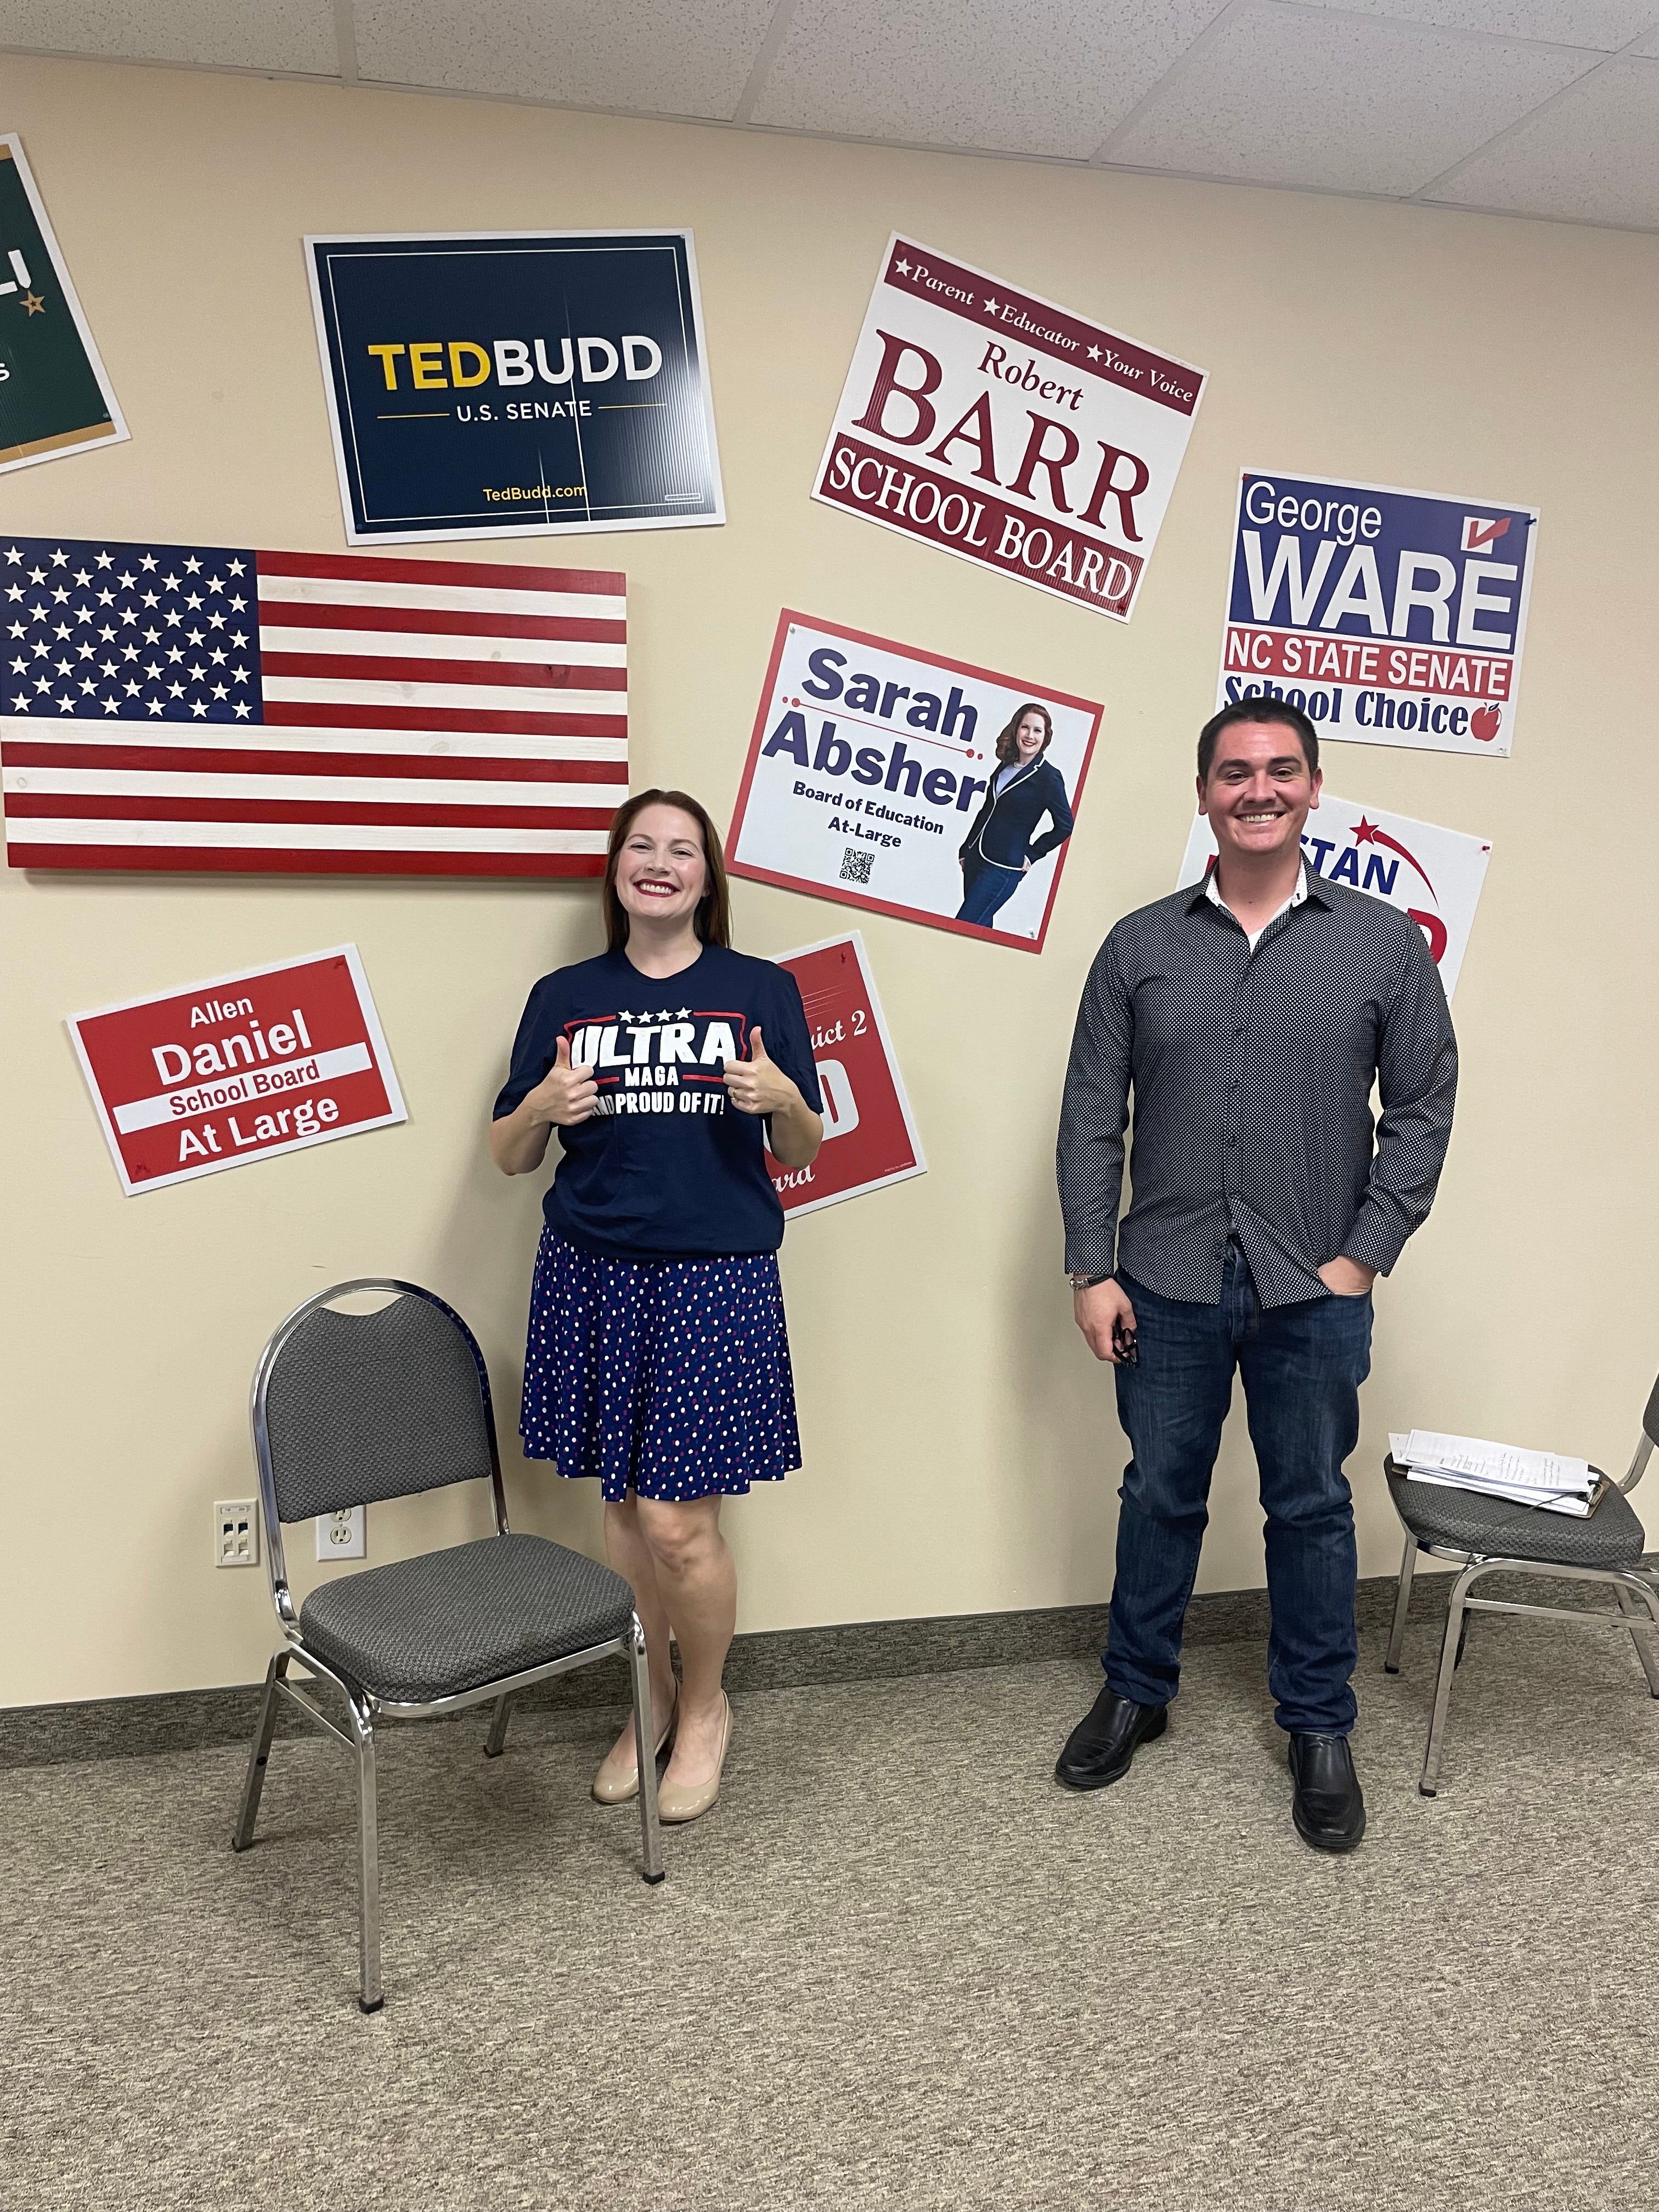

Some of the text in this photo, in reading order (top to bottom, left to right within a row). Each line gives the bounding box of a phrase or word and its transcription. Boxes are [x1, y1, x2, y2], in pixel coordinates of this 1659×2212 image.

[911, 264, 1194, 403] Parent Educator Your Voice
[977, 341, 1085, 410] Robert
[456, 400, 592, 422] U.S. SENATE
[851, 328, 1150, 543] BARR
[483, 486, 586, 501] TedBudd.com
[1245, 481, 1382, 546] George
[829, 447, 1133, 602] SCHOOL BOARD
[1242, 529, 1519, 650] WARE
[1227, 631, 1508, 696] NC STATE SENATE
[801, 648, 978, 742] Sarah
[1355, 691, 1469, 737] Choice
[761, 710, 987, 812] Absher
[793, 781, 944, 834] Board of Education
[828, 816, 901, 848] At-Large
[1300, 834, 1400, 895] TAN
[190, 998, 254, 1029] Allen
[851, 1010, 867, 1036] 2
[151, 1008, 312, 1086] Daniel
[571, 1022, 736, 1069] ULTRA
[625, 1065, 679, 1087] MAGA
[170, 1059, 320, 1116] School Board
[615, 1092, 674, 1114] PROUD
[679, 1091, 702, 1114] OF
[703, 1093, 725, 1115] IT!
[178, 1097, 339, 1162] At Large
